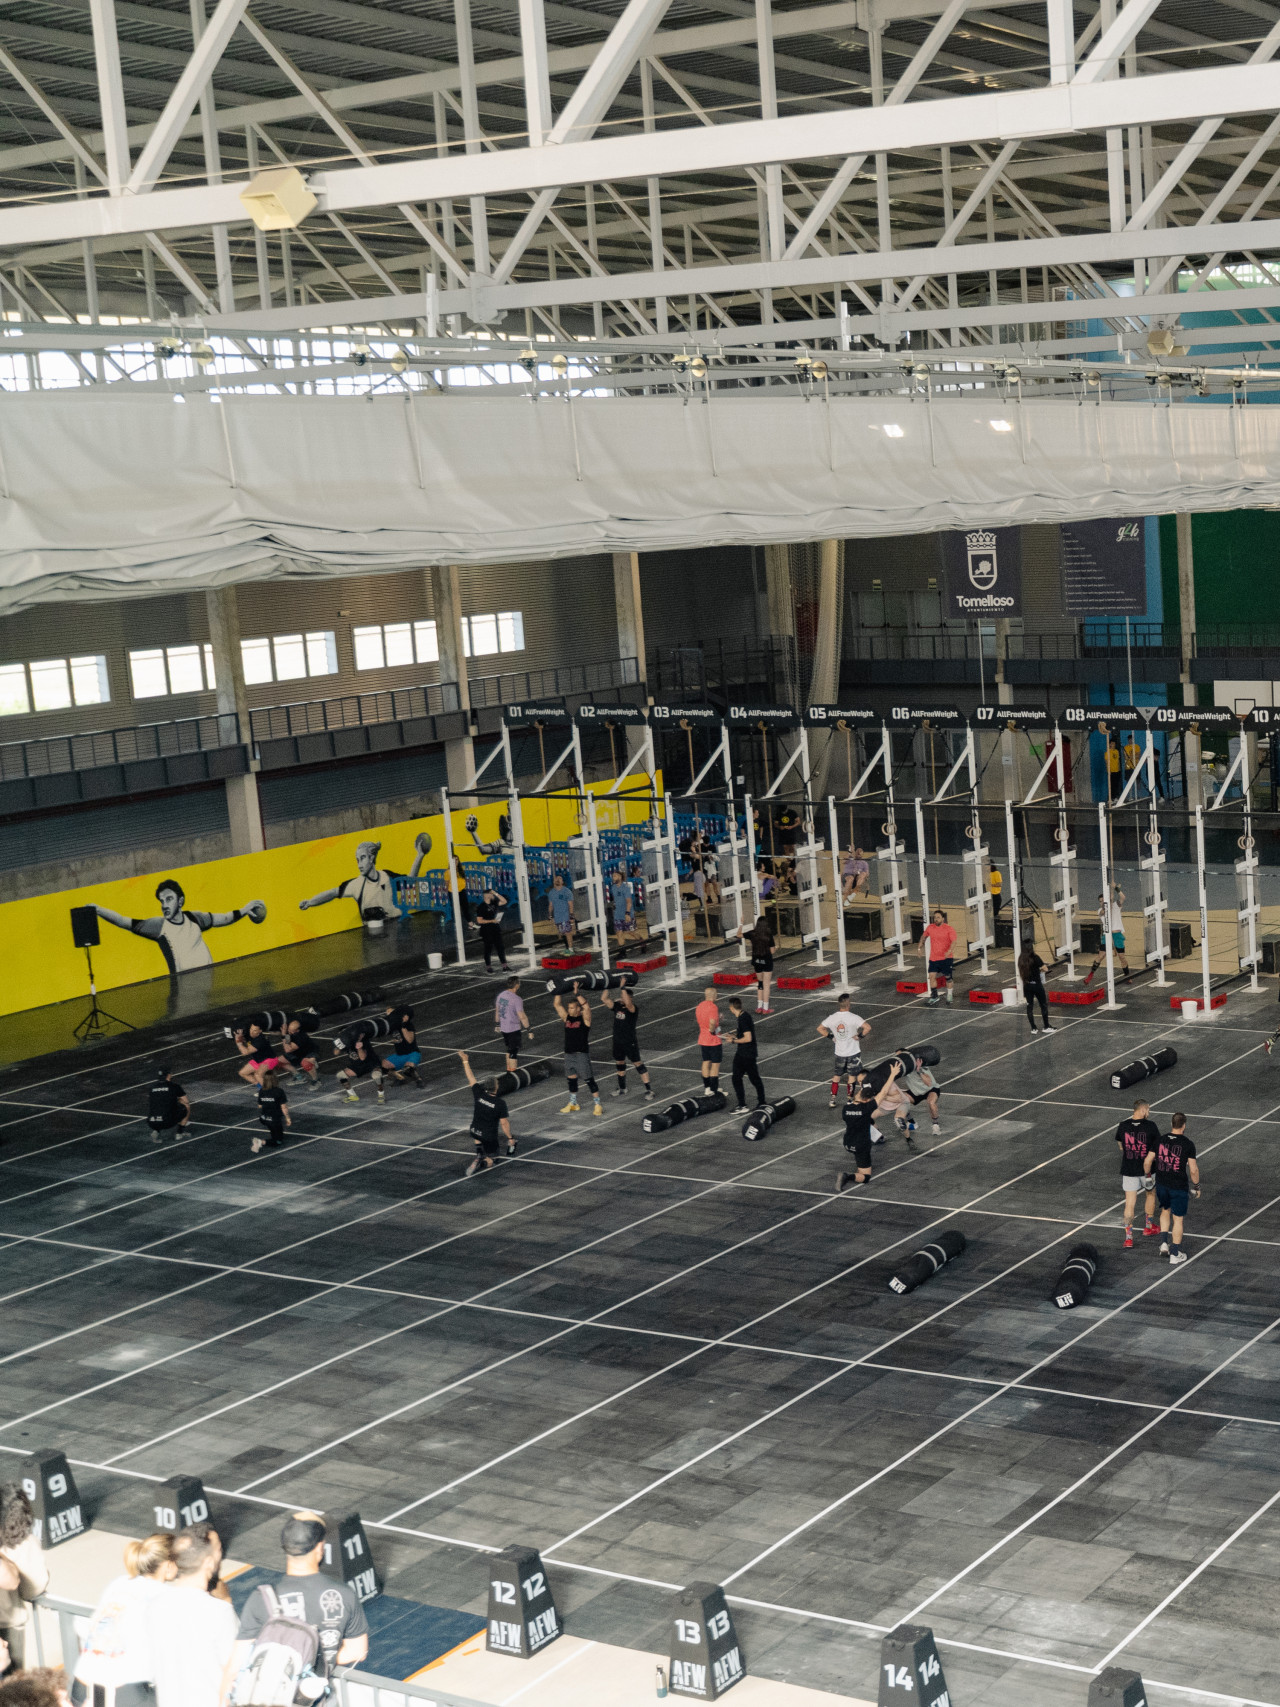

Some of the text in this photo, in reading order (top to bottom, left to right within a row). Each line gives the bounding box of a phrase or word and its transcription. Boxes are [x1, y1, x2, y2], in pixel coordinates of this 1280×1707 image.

[956, 594, 1014, 607] Tomelloso
[510, 707, 521, 717] 01
[580, 706, 595, 717] 02
[654, 707, 669, 717] 03
[731, 707, 747, 718] 04
[810, 708, 874, 719] 05 AllFreeWeight
[892, 708, 958, 719] 06 AllFreeWeight
[977, 709, 1046, 719] 07 AllFreeWeight
[1066, 709, 1137, 721] 08 AllFreeWeight
[1158, 710, 1231, 721] 09 AllFreeWeight
[1252, 711, 1269, 722] 10
[22, 1478, 36, 1501] 9
[49, 1473, 67, 1498] 9
[153, 1506, 176, 1530] 10
[180, 1499, 209, 1526] 10
[344, 1533, 364, 1560] 11
[491, 1580, 516, 1605] 12
[522, 1572, 546, 1601] 12
[674, 1618, 701, 1644] 13
[707, 1610, 730, 1640] 13
[883, 1663, 913, 1691] 14
[918, 1653, 940, 1686] 14
